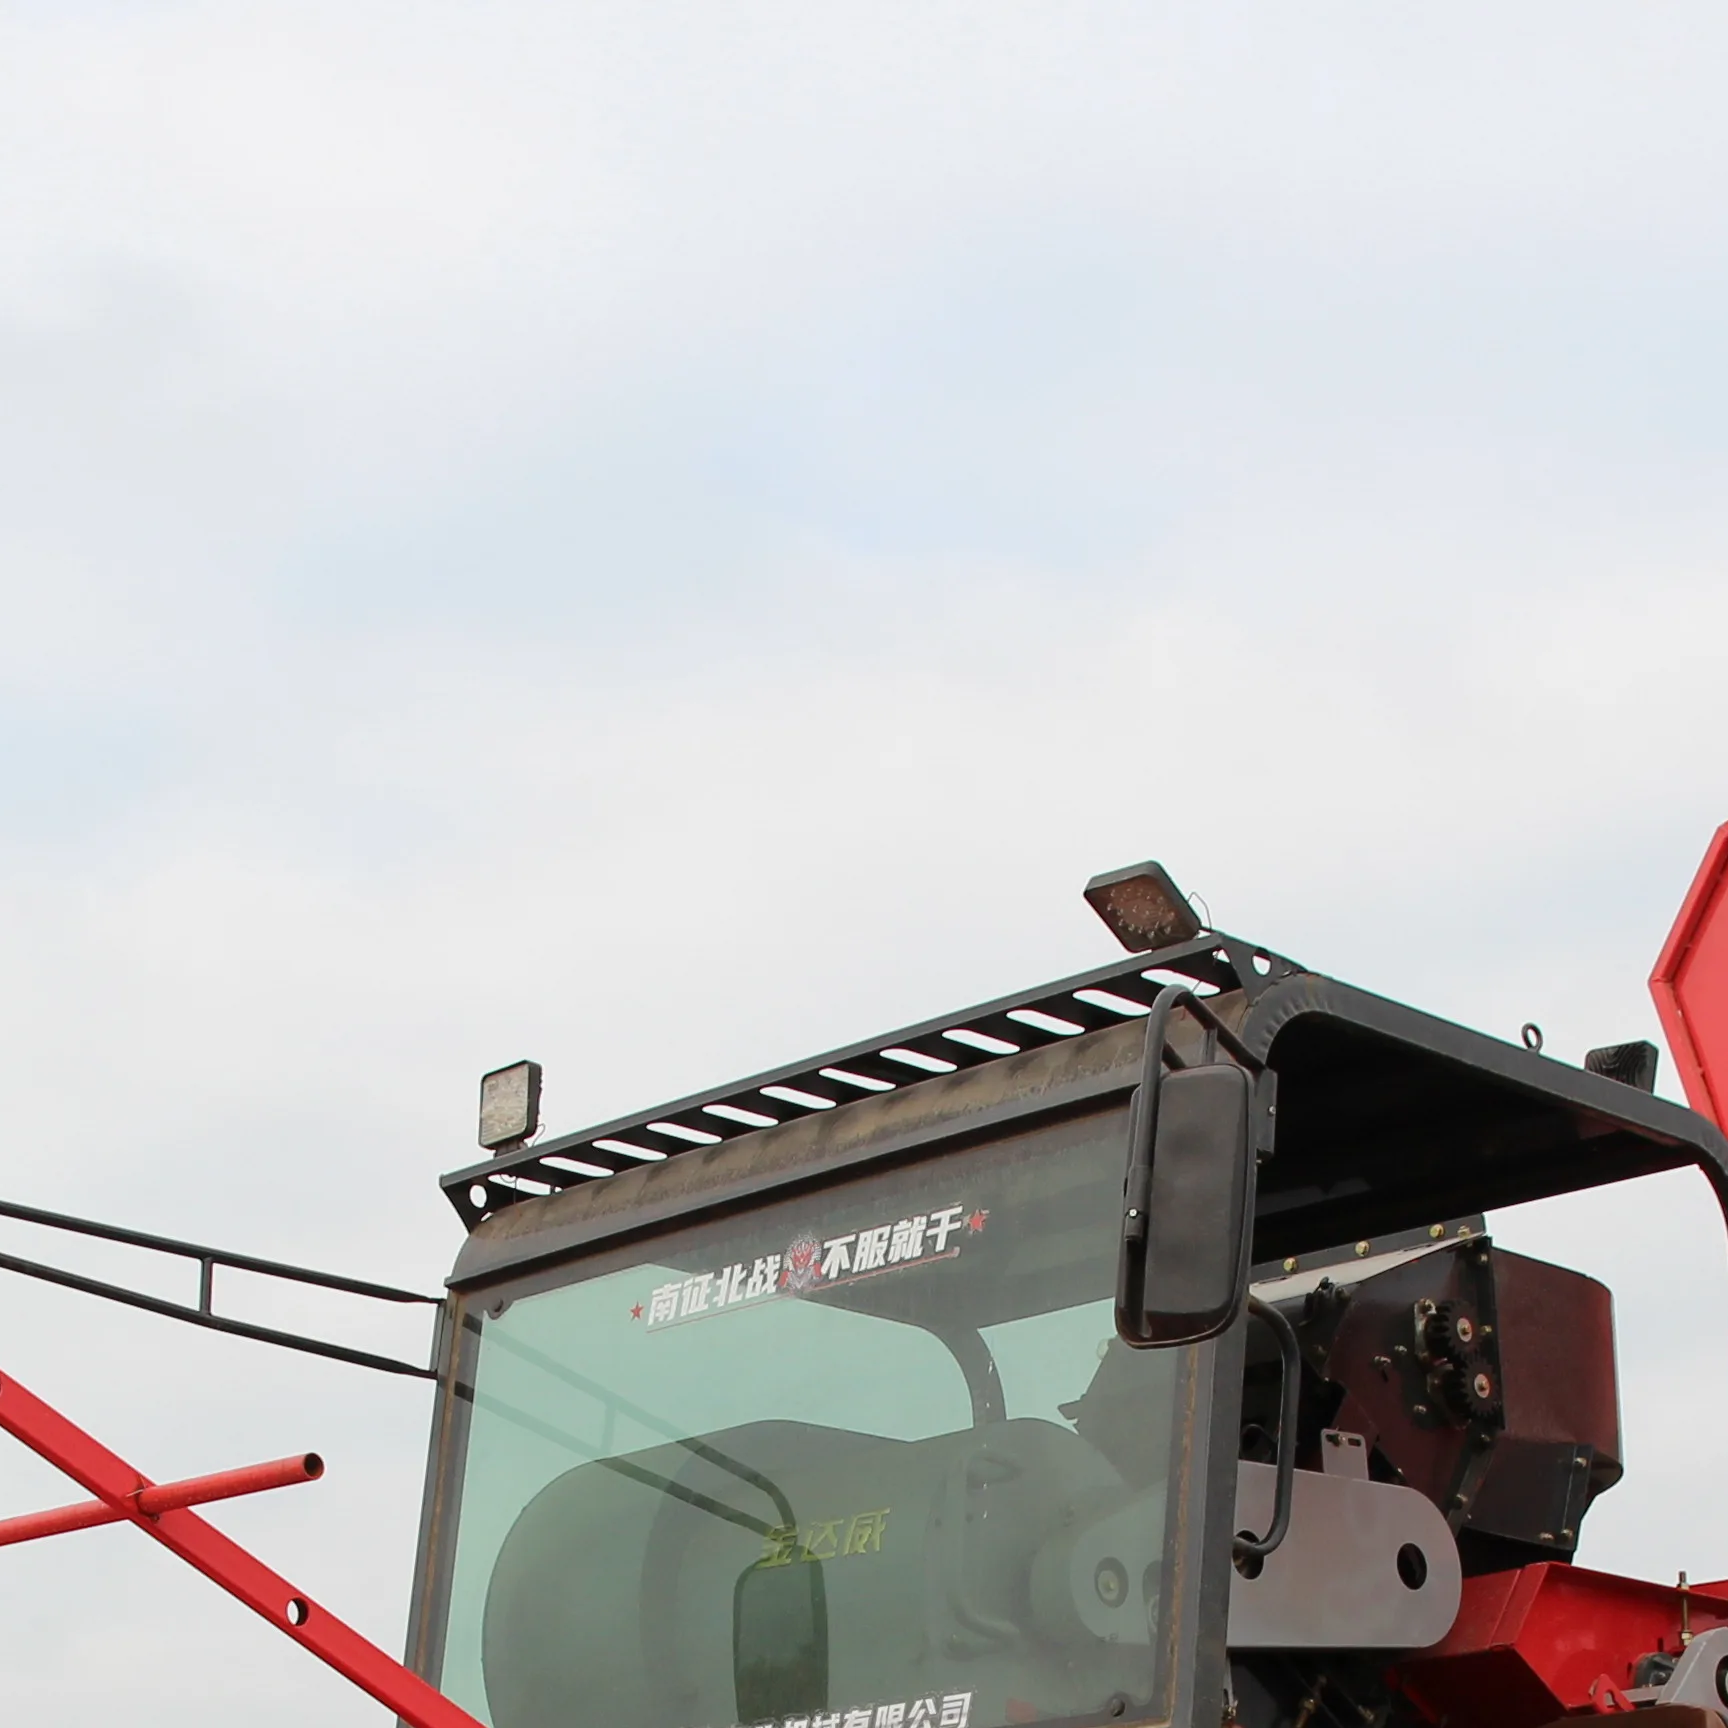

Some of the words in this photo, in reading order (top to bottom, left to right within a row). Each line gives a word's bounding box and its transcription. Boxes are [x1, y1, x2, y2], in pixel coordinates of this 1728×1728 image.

[646, 1254, 782, 1326] 南征北战
[821, 1205, 964, 1280] 不服就干
